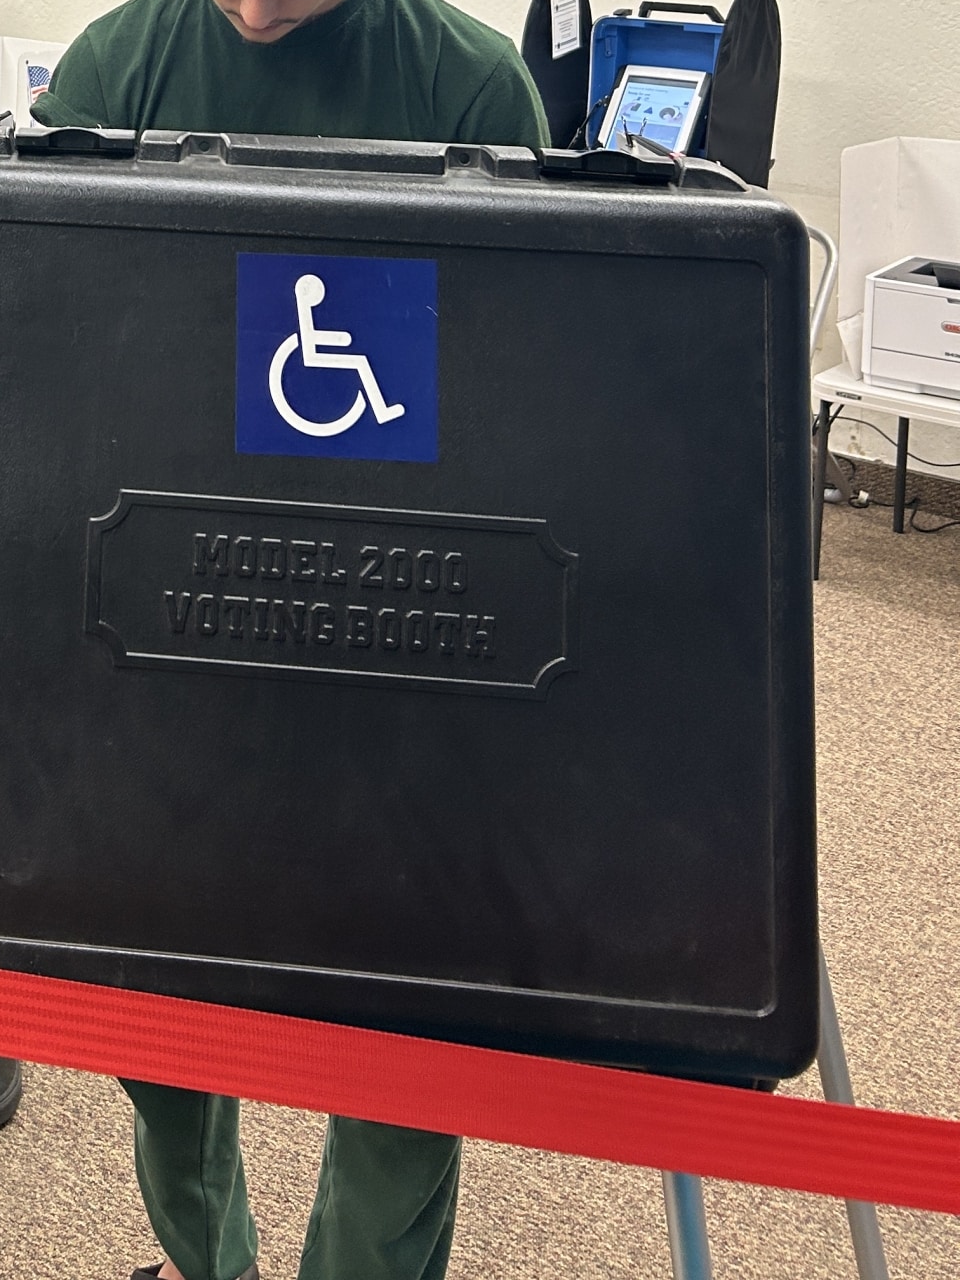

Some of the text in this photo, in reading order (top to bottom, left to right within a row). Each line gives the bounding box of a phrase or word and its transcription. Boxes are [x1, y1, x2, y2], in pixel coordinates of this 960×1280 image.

[193, 532, 468, 594] MODEL 2000
[163, 590, 496, 658] VOTING BOOTH
